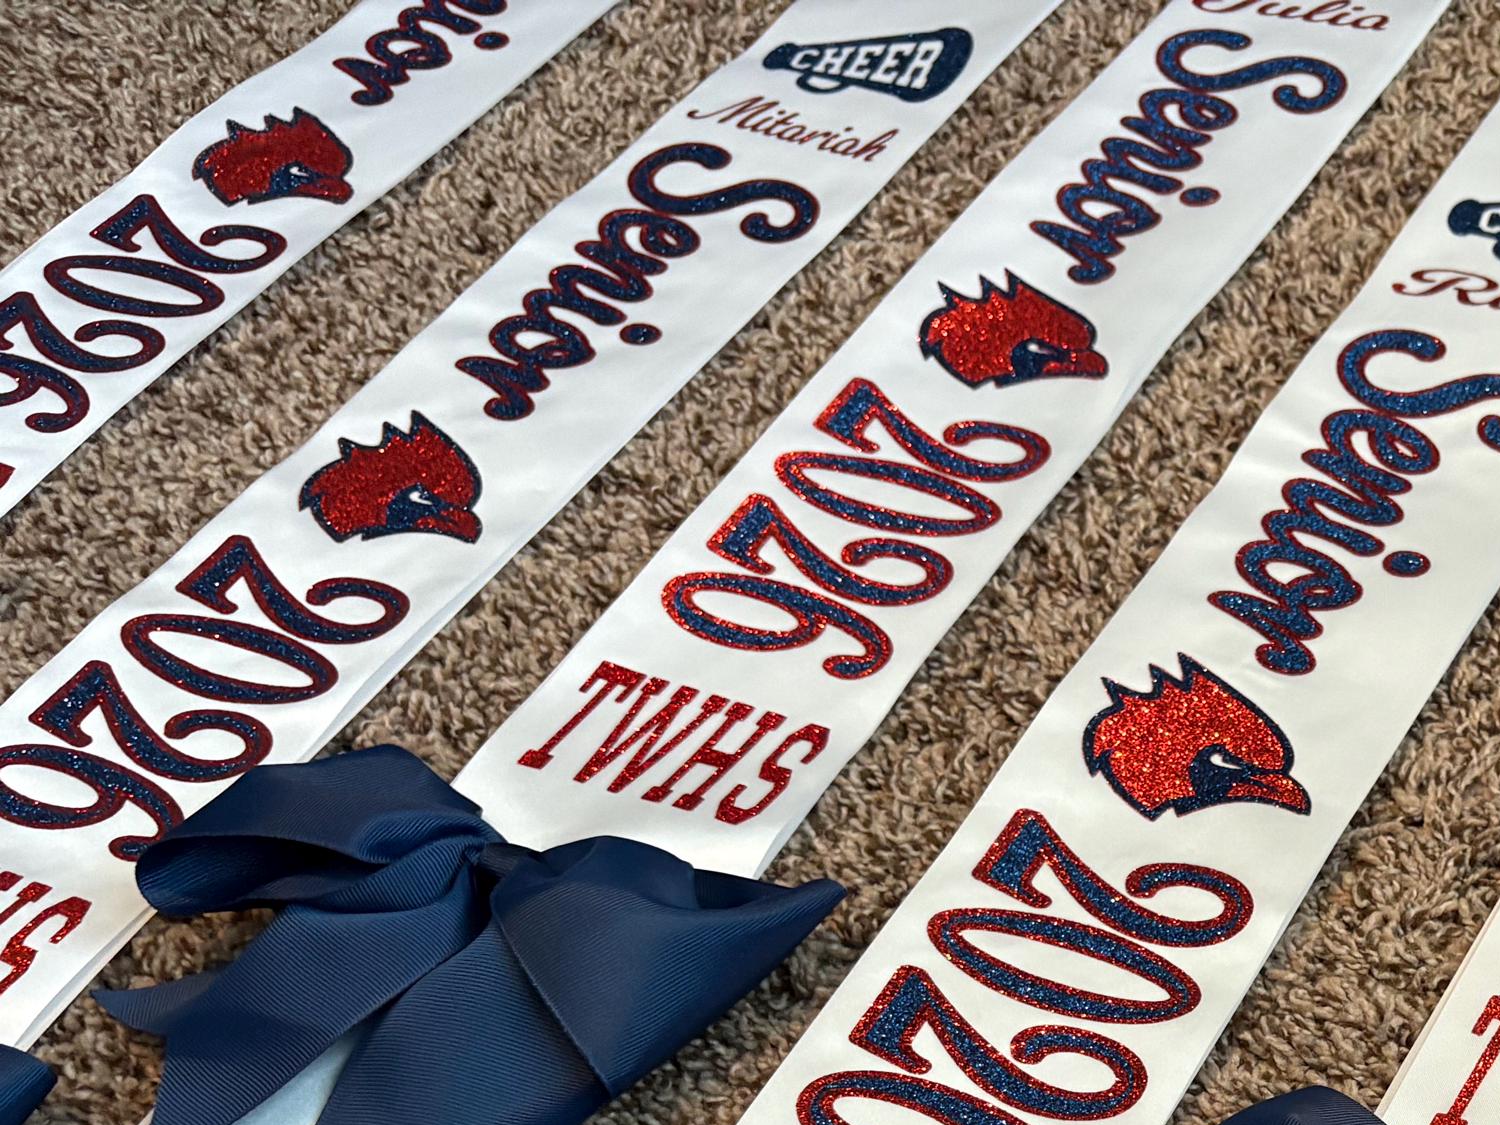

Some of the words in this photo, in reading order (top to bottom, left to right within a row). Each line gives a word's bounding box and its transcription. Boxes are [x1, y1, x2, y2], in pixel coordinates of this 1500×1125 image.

[332, 0, 509, 106] ior
[789, 40, 944, 89] CHEER
[1030, 28, 1347, 284] Senior
[455, 142, 819, 421] Senior
[661, 377, 1051, 680] 2026
[0, 534, 410, 862] 2026
[517, 660, 831, 825] TWHS
